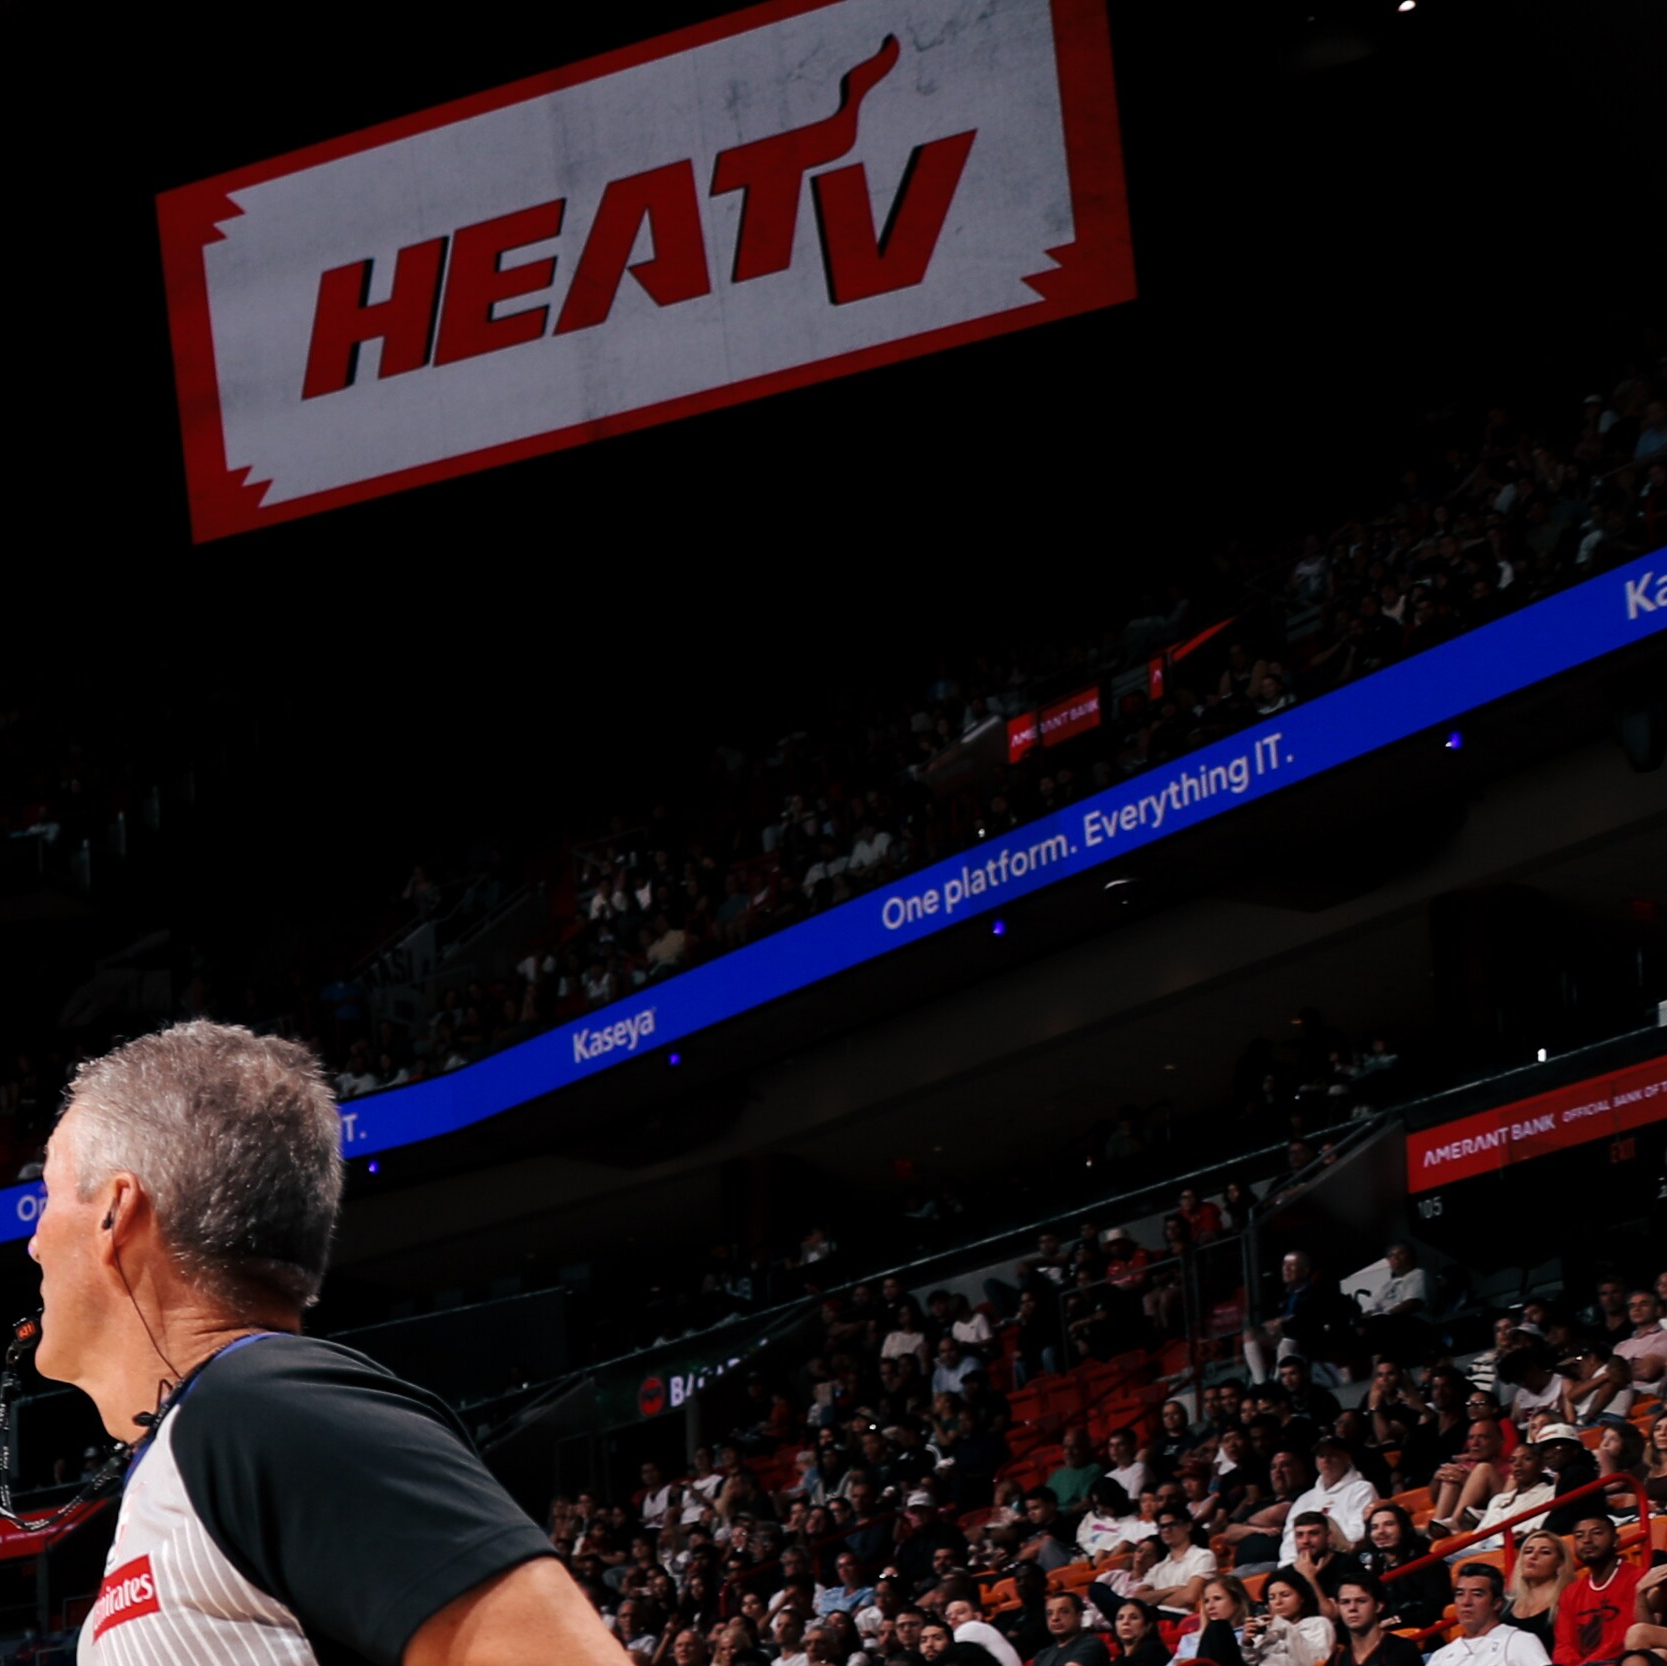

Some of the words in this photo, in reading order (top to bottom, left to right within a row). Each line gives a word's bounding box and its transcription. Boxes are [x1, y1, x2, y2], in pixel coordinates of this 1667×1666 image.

[880, 892, 938, 931] One
[944, 833, 1080, 914] platform.
[1082, 760, 1251, 850] Everything
[1253, 732, 1295, 776] IT.
[572, 1009, 656, 1065] Kaseya
[1562, 1100, 1611, 1123] OFFICIAL
[1613, 1089, 1644, 1108] BANK
[1422, 1127, 1510, 1169] AMERANT
[1510, 1113, 1556, 1142] BANK
